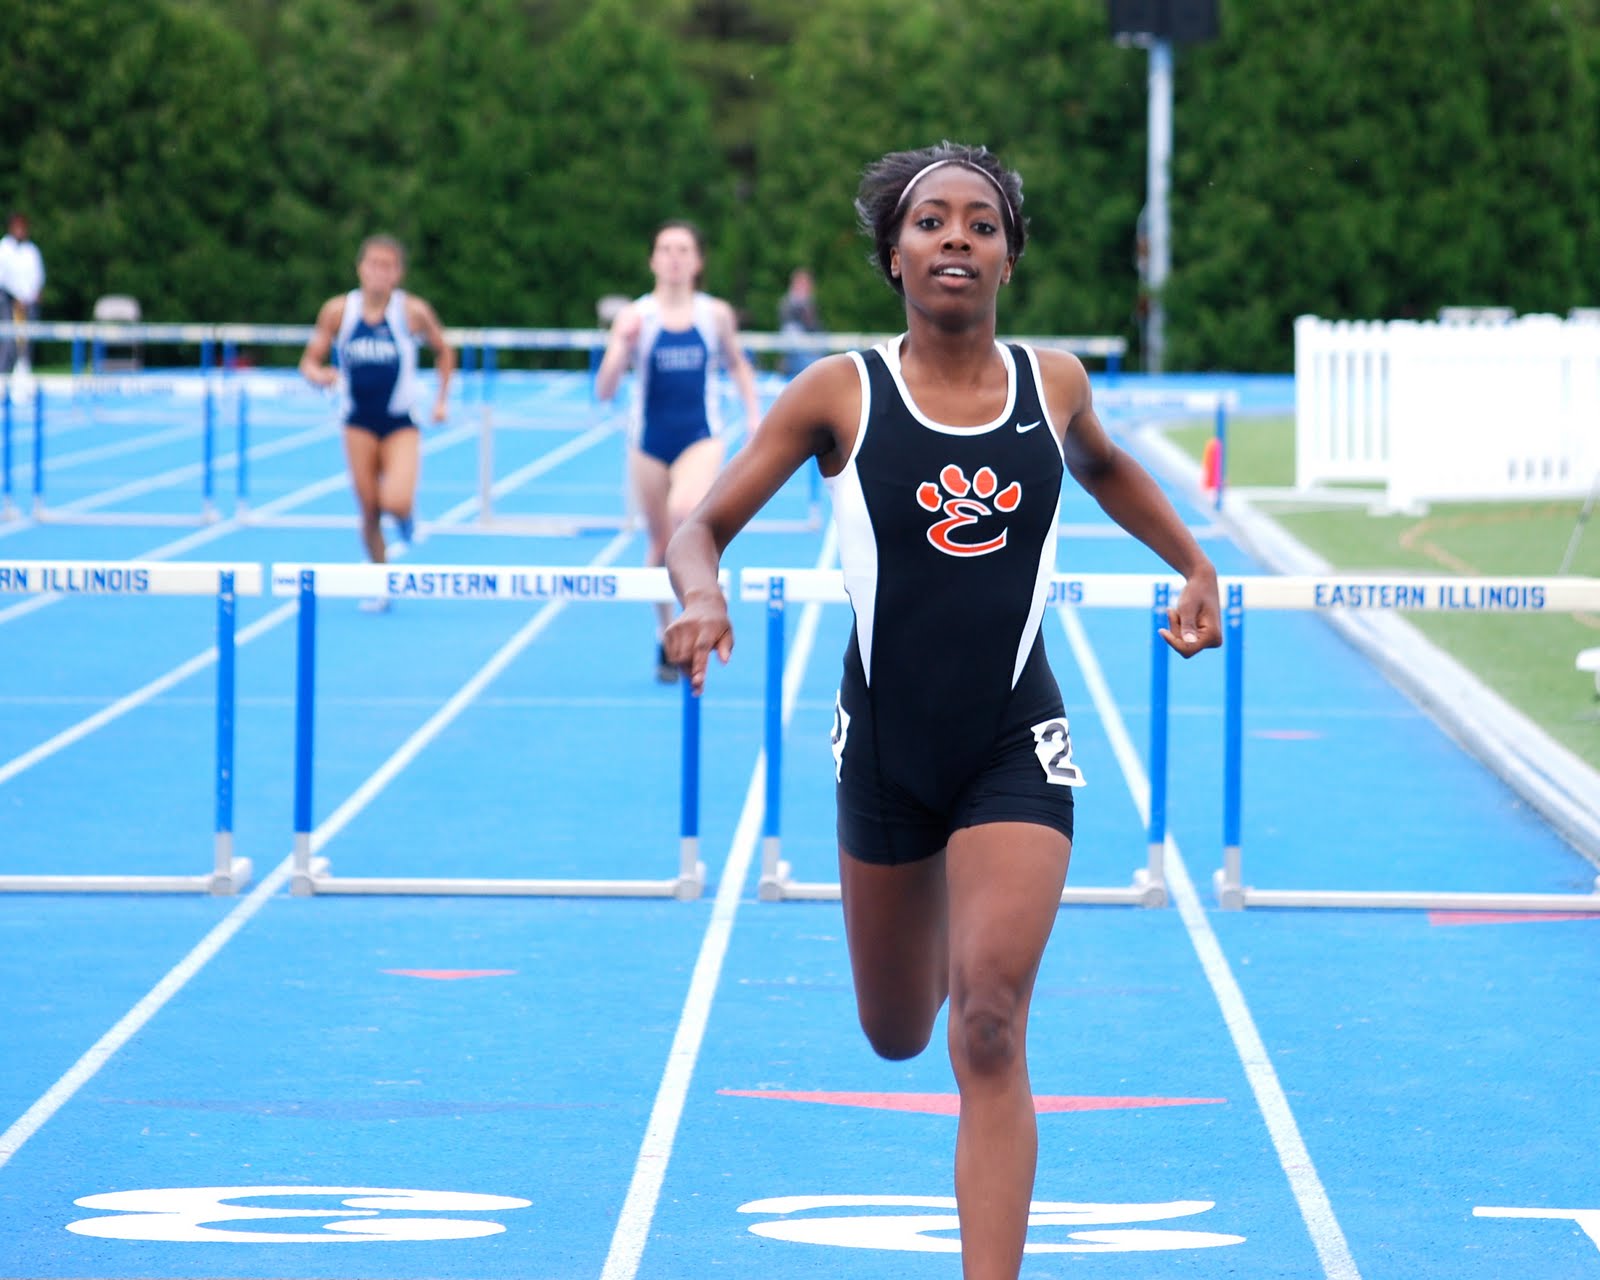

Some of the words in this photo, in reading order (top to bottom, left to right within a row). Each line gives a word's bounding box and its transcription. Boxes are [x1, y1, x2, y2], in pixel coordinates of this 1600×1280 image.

[41, 568, 149, 593] ILLINOIS
[386, 571, 498, 596] EASTERN
[511, 573, 617, 597] ILLINOIS
[1314, 583, 1425, 609] EASTERN
[1438, 585, 1546, 610] ILLINOIS
[1041, 722, 1077, 780] 2
[65, 1186, 533, 1243] 3
